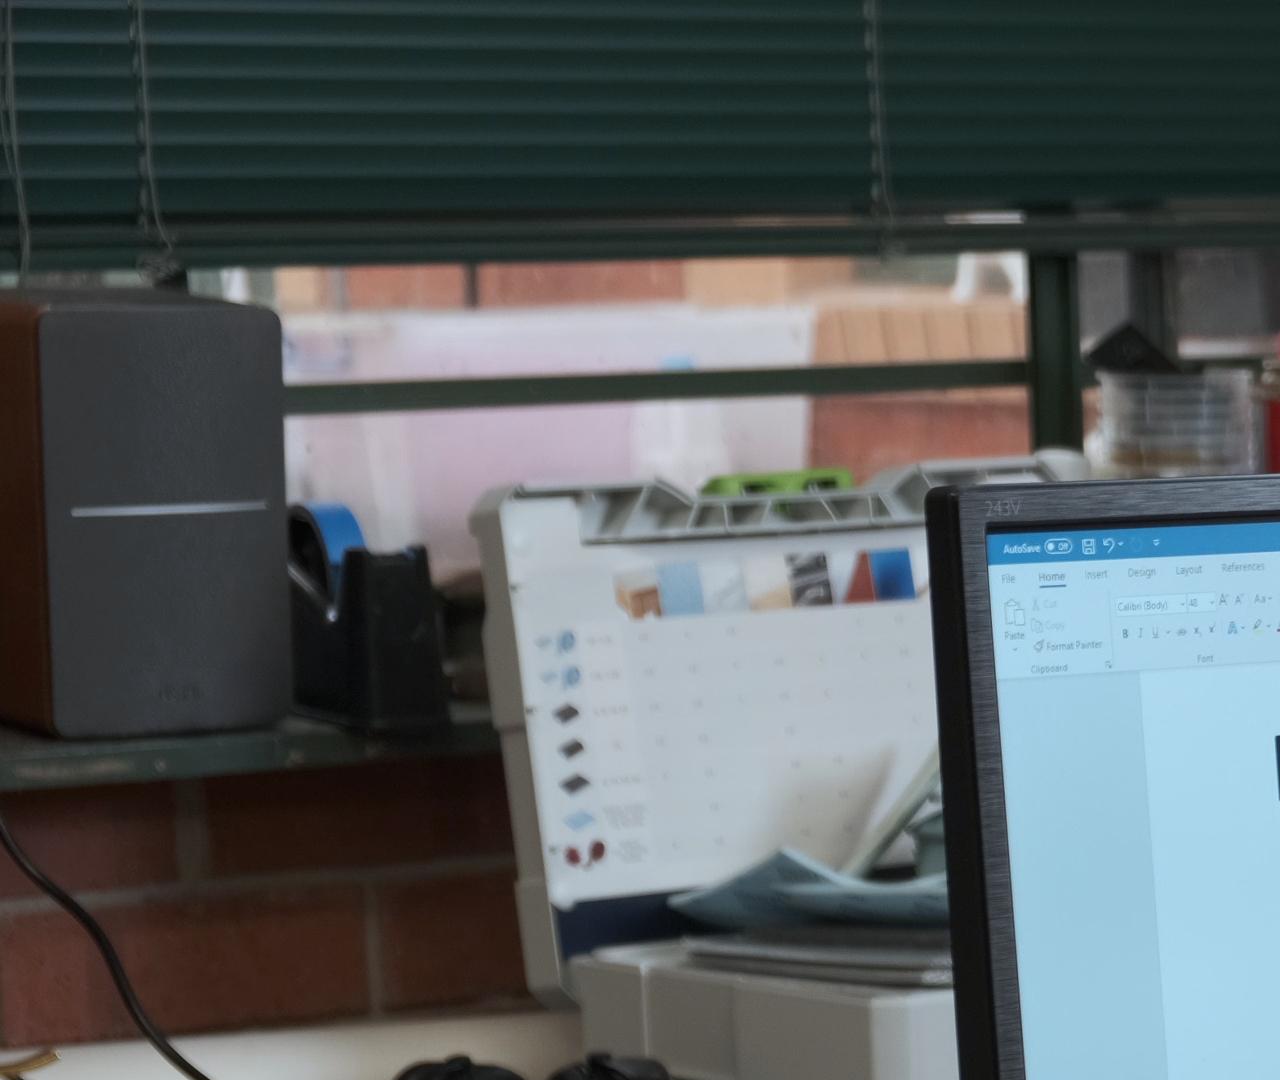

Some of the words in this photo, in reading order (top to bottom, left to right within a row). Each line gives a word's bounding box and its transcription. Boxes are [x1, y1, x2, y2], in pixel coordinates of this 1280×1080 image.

[1003, 543, 1041, 554] AutoSave
[1058, 543, 1069, 551] Off
[1127, 567, 1156, 579] Design
[1175, 565, 1203, 577] Layout
[1222, 562, 1265, 573] References
[1001, 574, 1016, 585] File
[1038, 571, 1066, 583] Home
[1085, 569, 1108, 580] Insert
[1117, 602, 1142, 612] Calibri
[1144, 601, 1169, 611] (Body)
[1004, 632, 1025, 641] Paste
[1047, 641, 1075, 652] Format
[1076, 640, 1103, 650] Painter
[1197, 654, 1214, 664] Font
[1030, 663, 1068, 675] Clipboard
